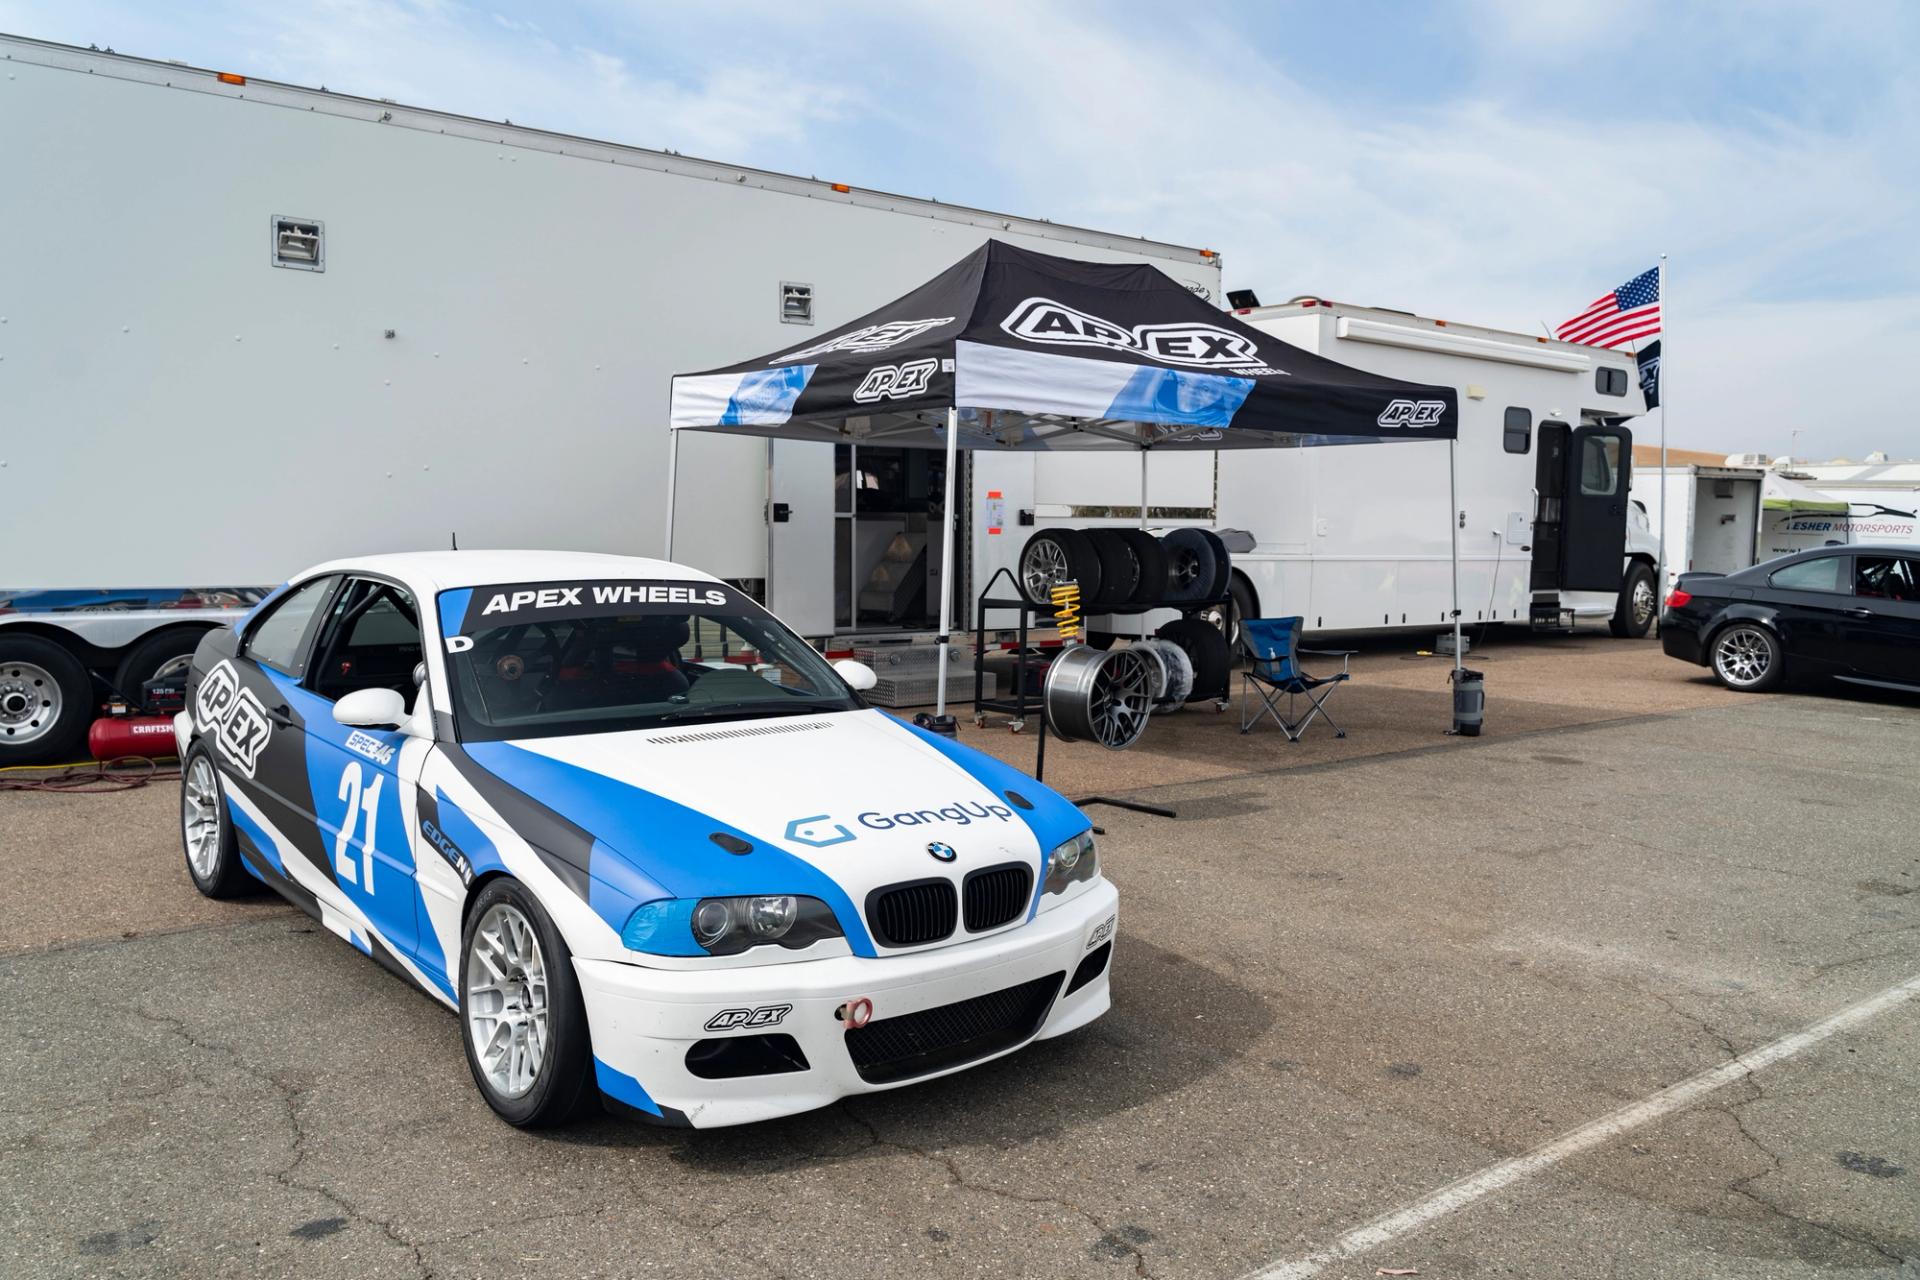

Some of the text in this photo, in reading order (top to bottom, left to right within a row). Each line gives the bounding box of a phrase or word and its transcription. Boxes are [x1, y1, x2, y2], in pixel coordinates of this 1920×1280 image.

[1010, 301, 1257, 364] APEX
[856, 361, 933, 400] APEX
[1380, 401, 1444, 425] APEX
[1832, 522, 1914, 535] MOTORSPORTS
[482, 585, 727, 616] APEX WHEELS
[447, 636, 474, 654] D
[133, 724, 174, 734] CRAFTSM
[198, 666, 268, 770] APEX
[336, 760, 386, 897] 21
[857, 801, 1013, 830] GangUp
[706, 1005, 790, 1030] APEX
